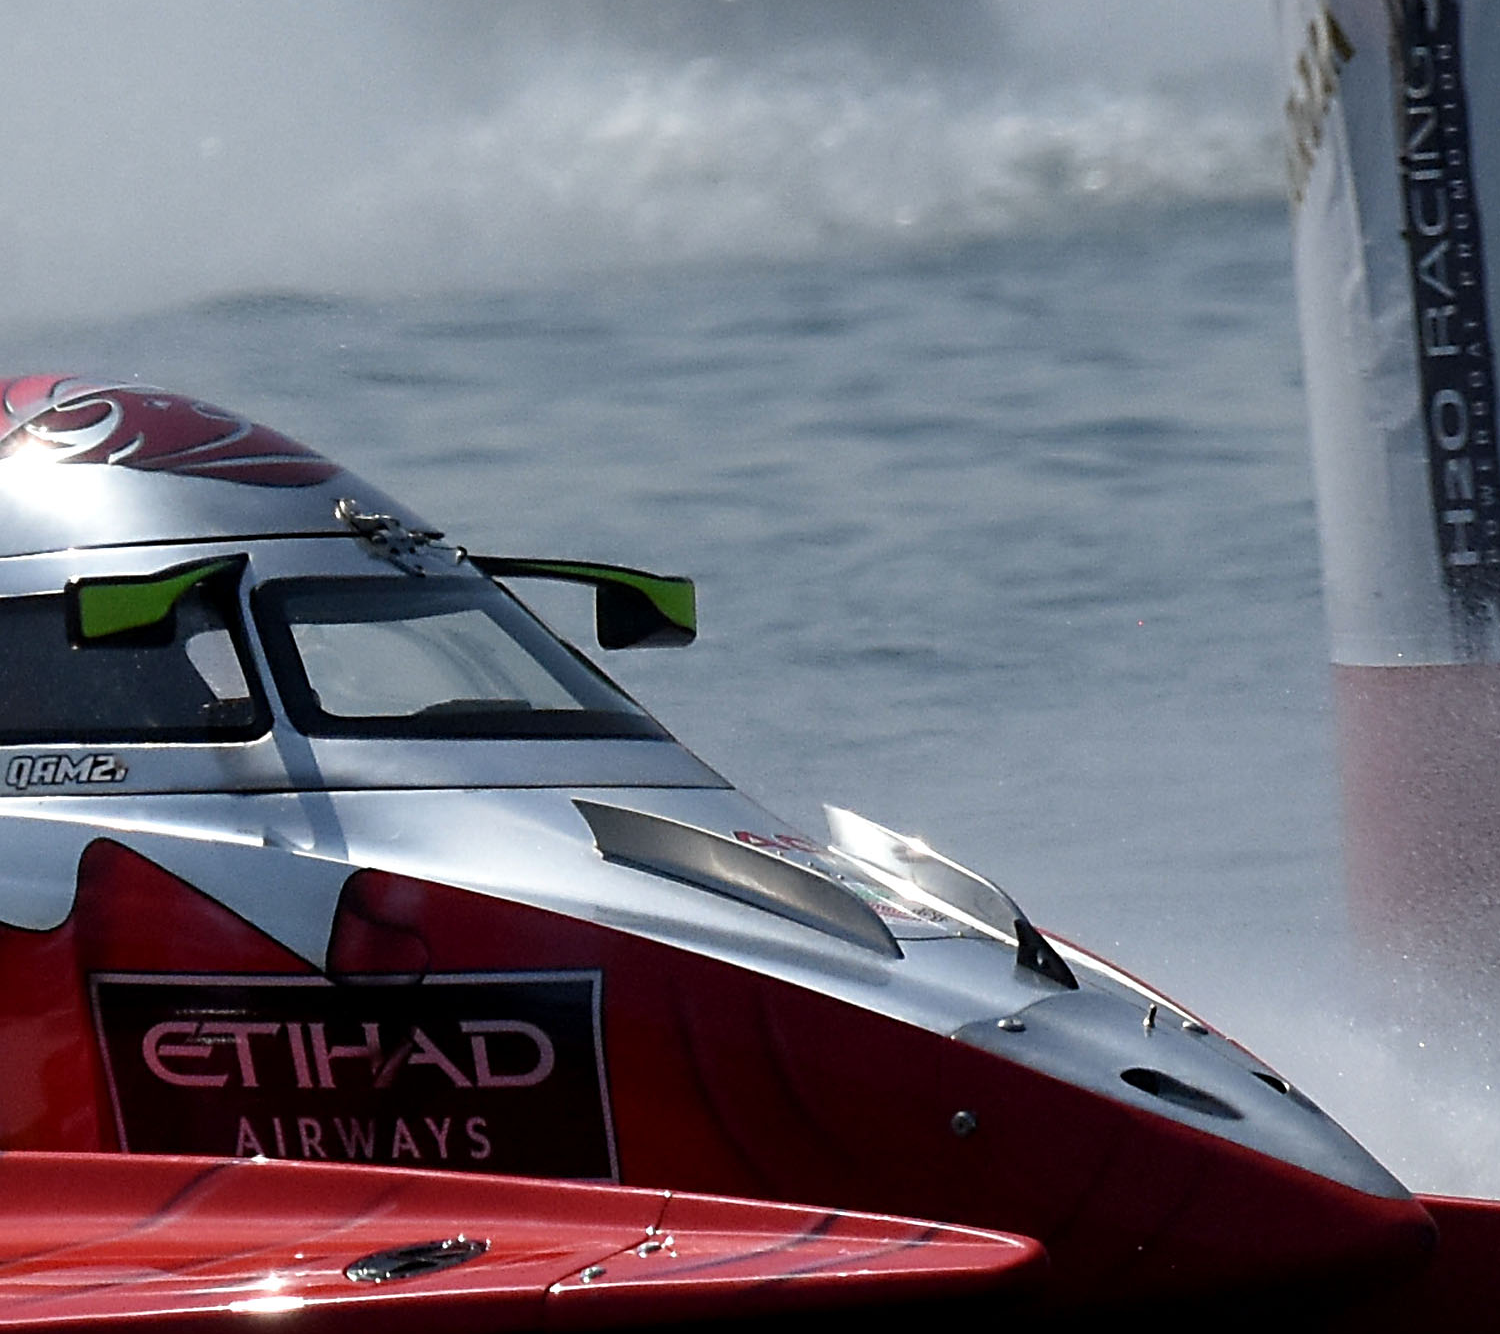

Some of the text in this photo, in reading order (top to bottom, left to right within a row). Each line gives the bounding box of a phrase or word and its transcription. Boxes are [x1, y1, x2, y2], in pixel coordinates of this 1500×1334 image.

[1403, 43, 1462, 359] RACING
[141, 1018, 557, 1090] ETIHAD
[234, 1114, 493, 1160] AIRWAYS
